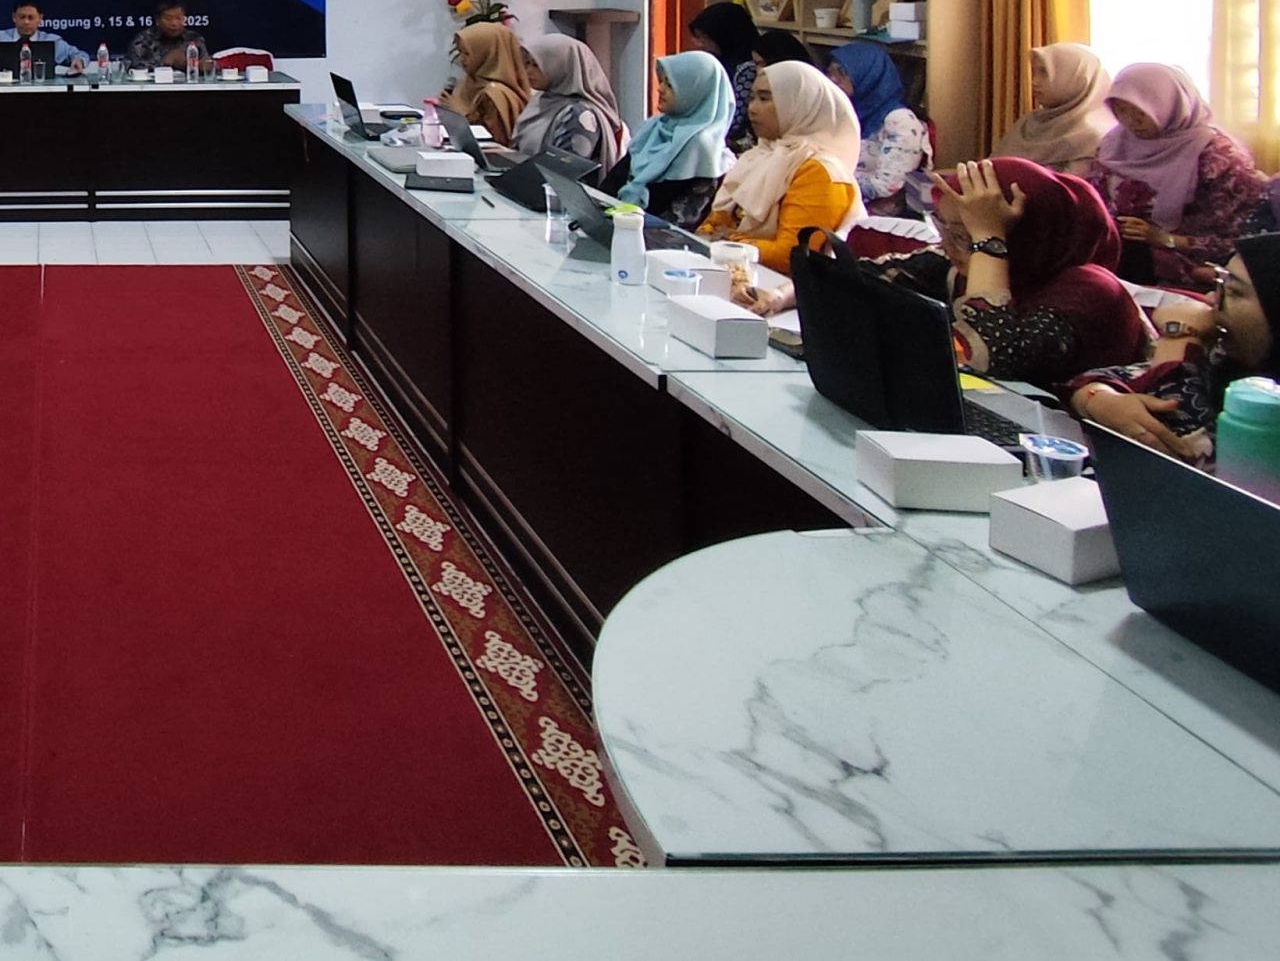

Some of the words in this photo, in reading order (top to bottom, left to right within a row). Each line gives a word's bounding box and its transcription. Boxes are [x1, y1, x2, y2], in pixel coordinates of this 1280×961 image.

[93, 16, 105, 28] 9,
[108, 16, 123, 27] 15
[125, 16, 135, 27] &
[138, 15, 153, 27] 16
[181, 15, 210, 27] 2025
